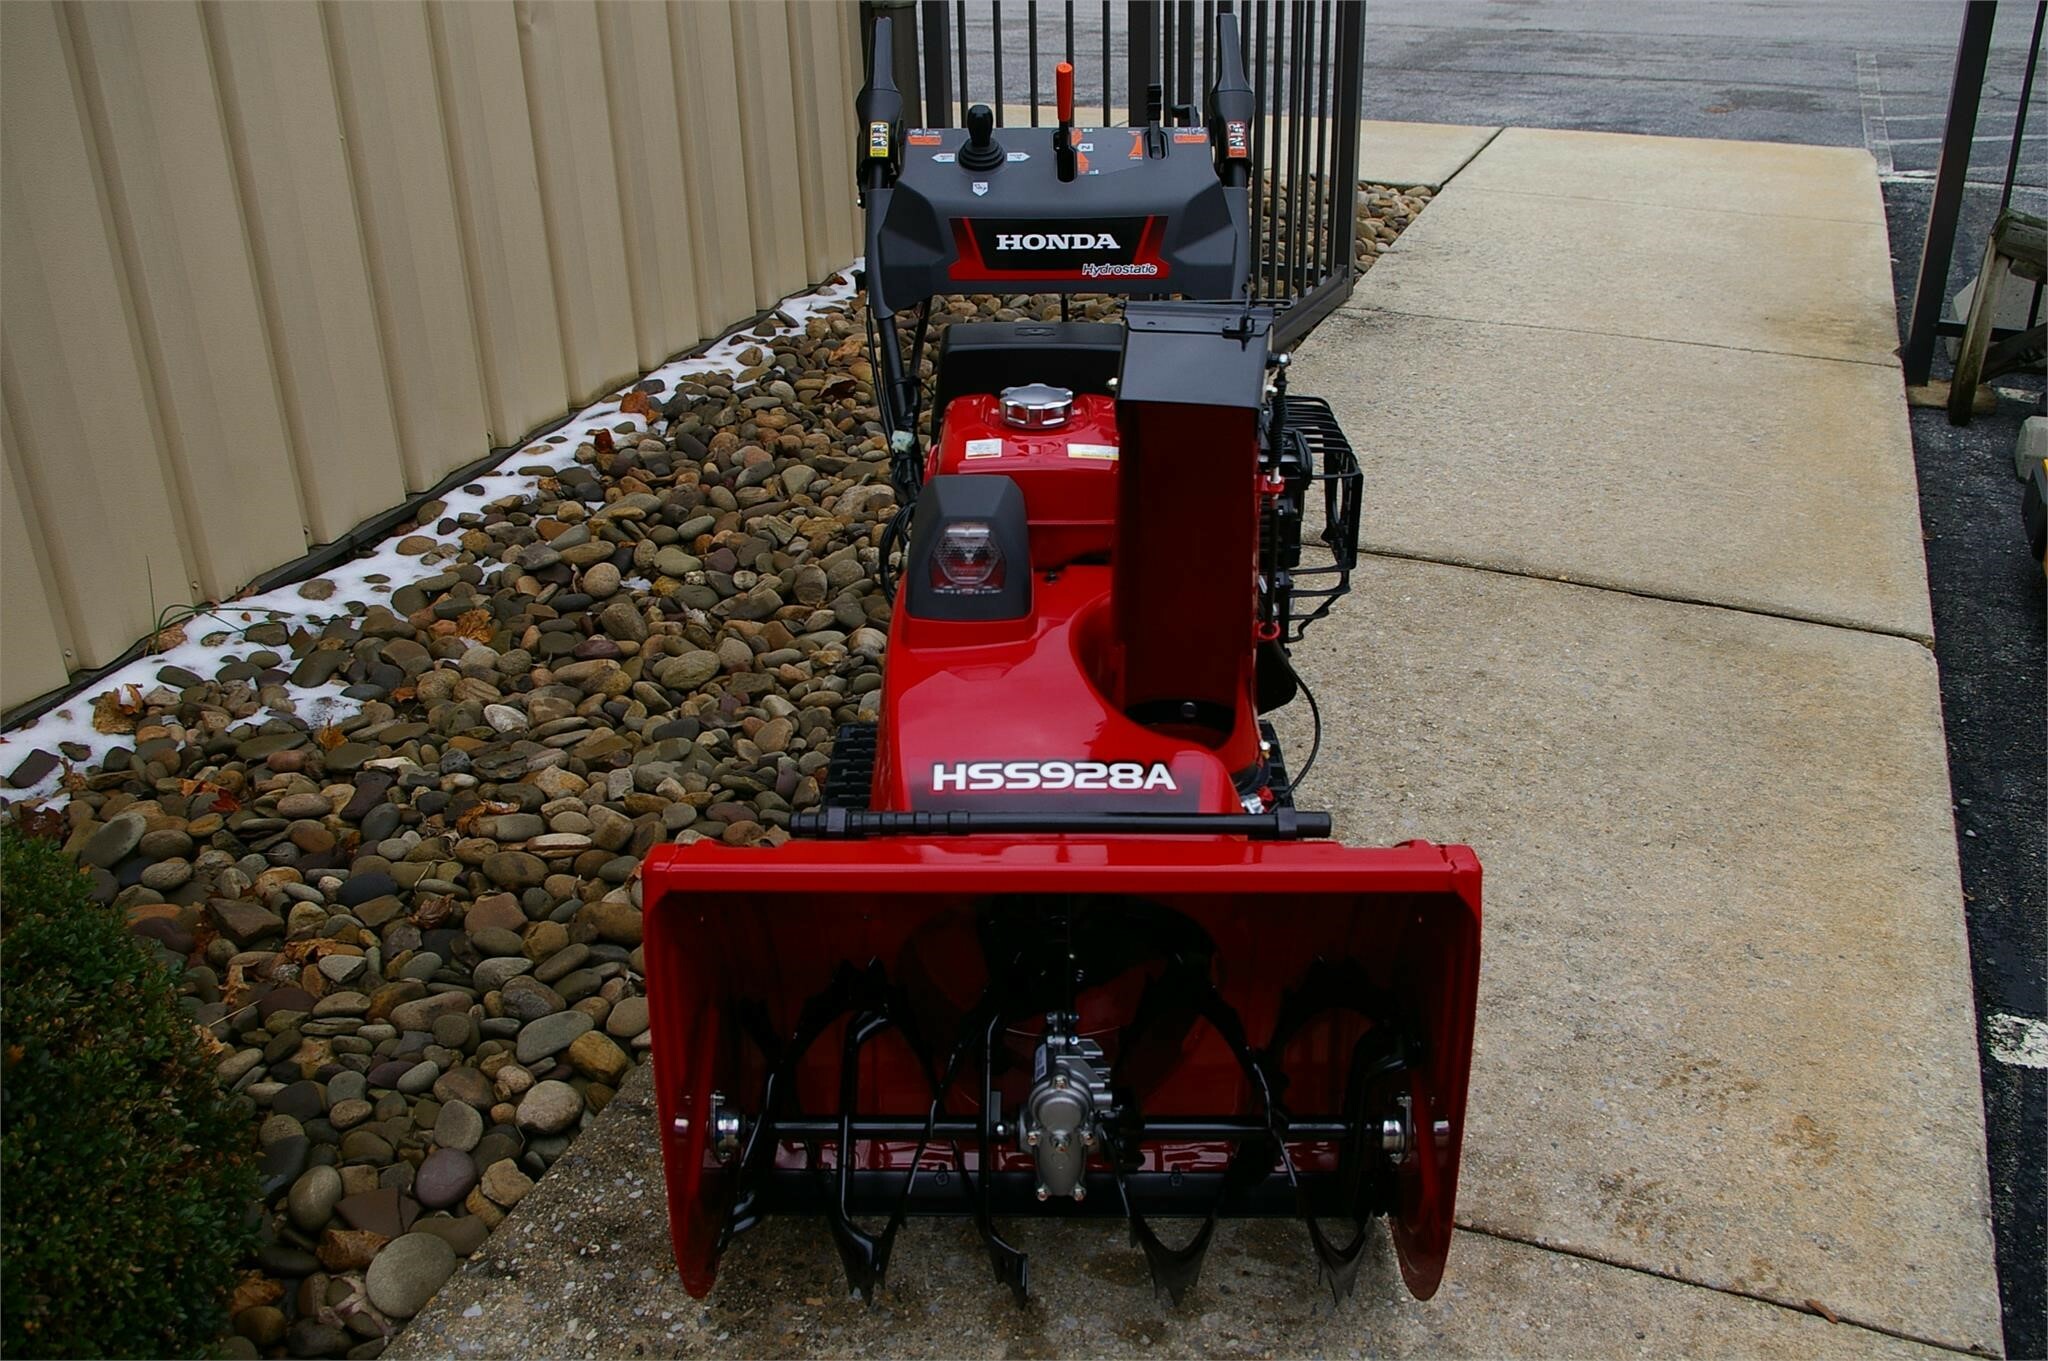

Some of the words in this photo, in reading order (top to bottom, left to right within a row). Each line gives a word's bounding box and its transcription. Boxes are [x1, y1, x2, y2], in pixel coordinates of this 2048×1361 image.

[996, 234, 1120, 250] HONDA
[1082, 263, 1157, 277] Hydrostatic
[932, 761, 1178, 791] HSS928A
